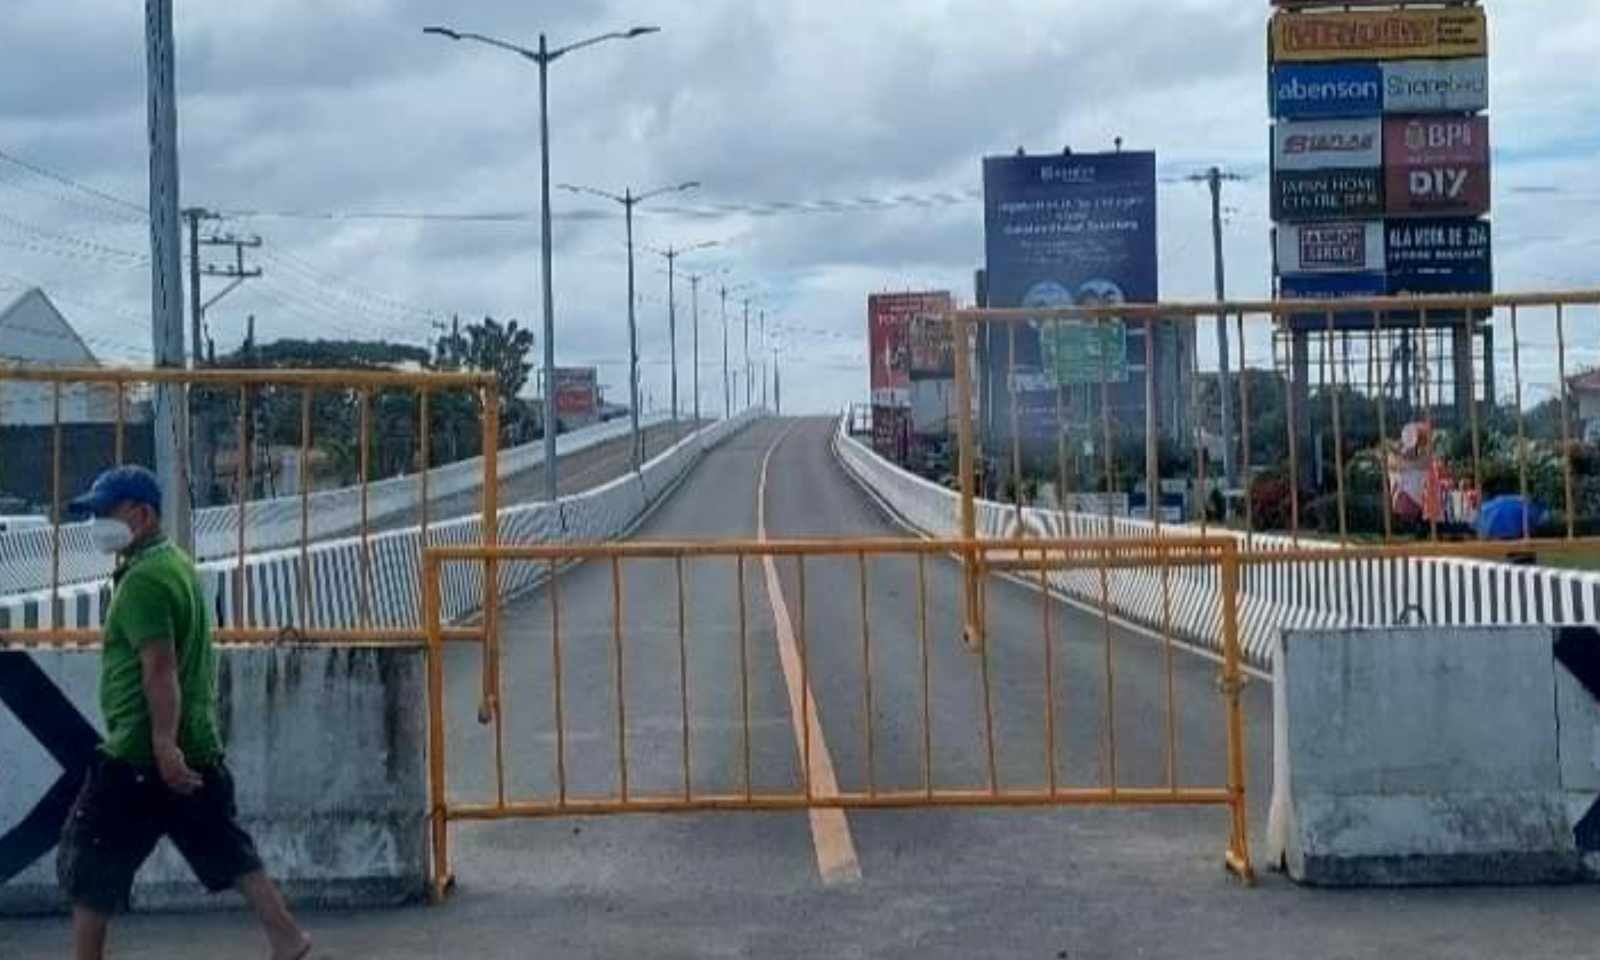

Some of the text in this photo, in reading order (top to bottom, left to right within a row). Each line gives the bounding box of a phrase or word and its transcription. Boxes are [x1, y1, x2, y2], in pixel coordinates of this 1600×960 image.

[1279, 78, 1377, 99] abenson
[1429, 122, 1471, 148] BPI
[1410, 168, 1468, 197] DIY
